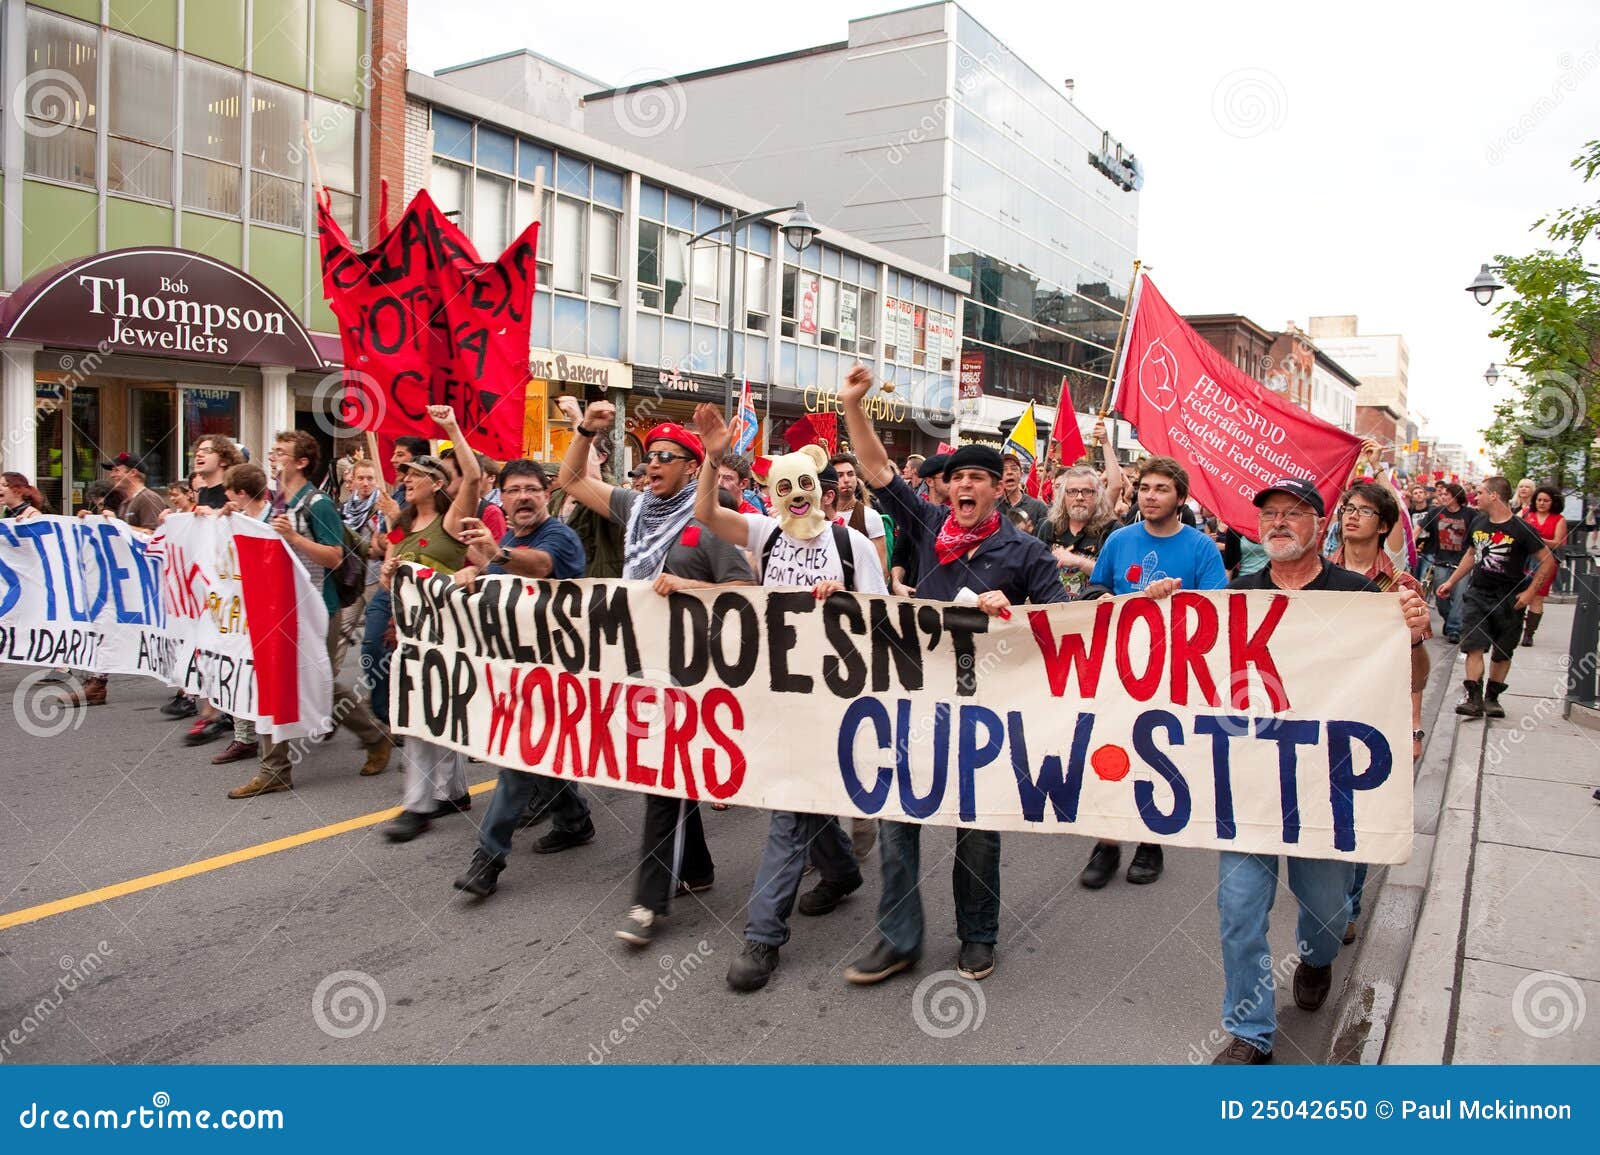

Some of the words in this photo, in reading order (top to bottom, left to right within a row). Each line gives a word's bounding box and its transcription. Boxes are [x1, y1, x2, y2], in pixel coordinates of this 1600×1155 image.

[79, 275, 286, 335] Thompson
[160, 276, 189, 294] Bob
[108, 317, 229, 354] Jewellers
[530, 360, 552, 379] ons
[1180, 406, 1224, 454] Student
[1226, 446, 1283, 487] Federati
[1183, 391, 1260, 448] Fédération
[1255, 436, 1317, 481] étudiante
[1241, 408, 1287, 446] SFUO
[1220, 470, 1235, 486] 41
[399, 564, 645, 680] CAPITALISM
[668, 590, 989, 697] DOESN'T
[1027, 592, 1291, 713] WORK
[397, 644, 478, 746] FOR
[485, 663, 747, 800] WORKERS
[837, 696, 1095, 823] CUPW
[1132, 709, 1394, 853] STTP
